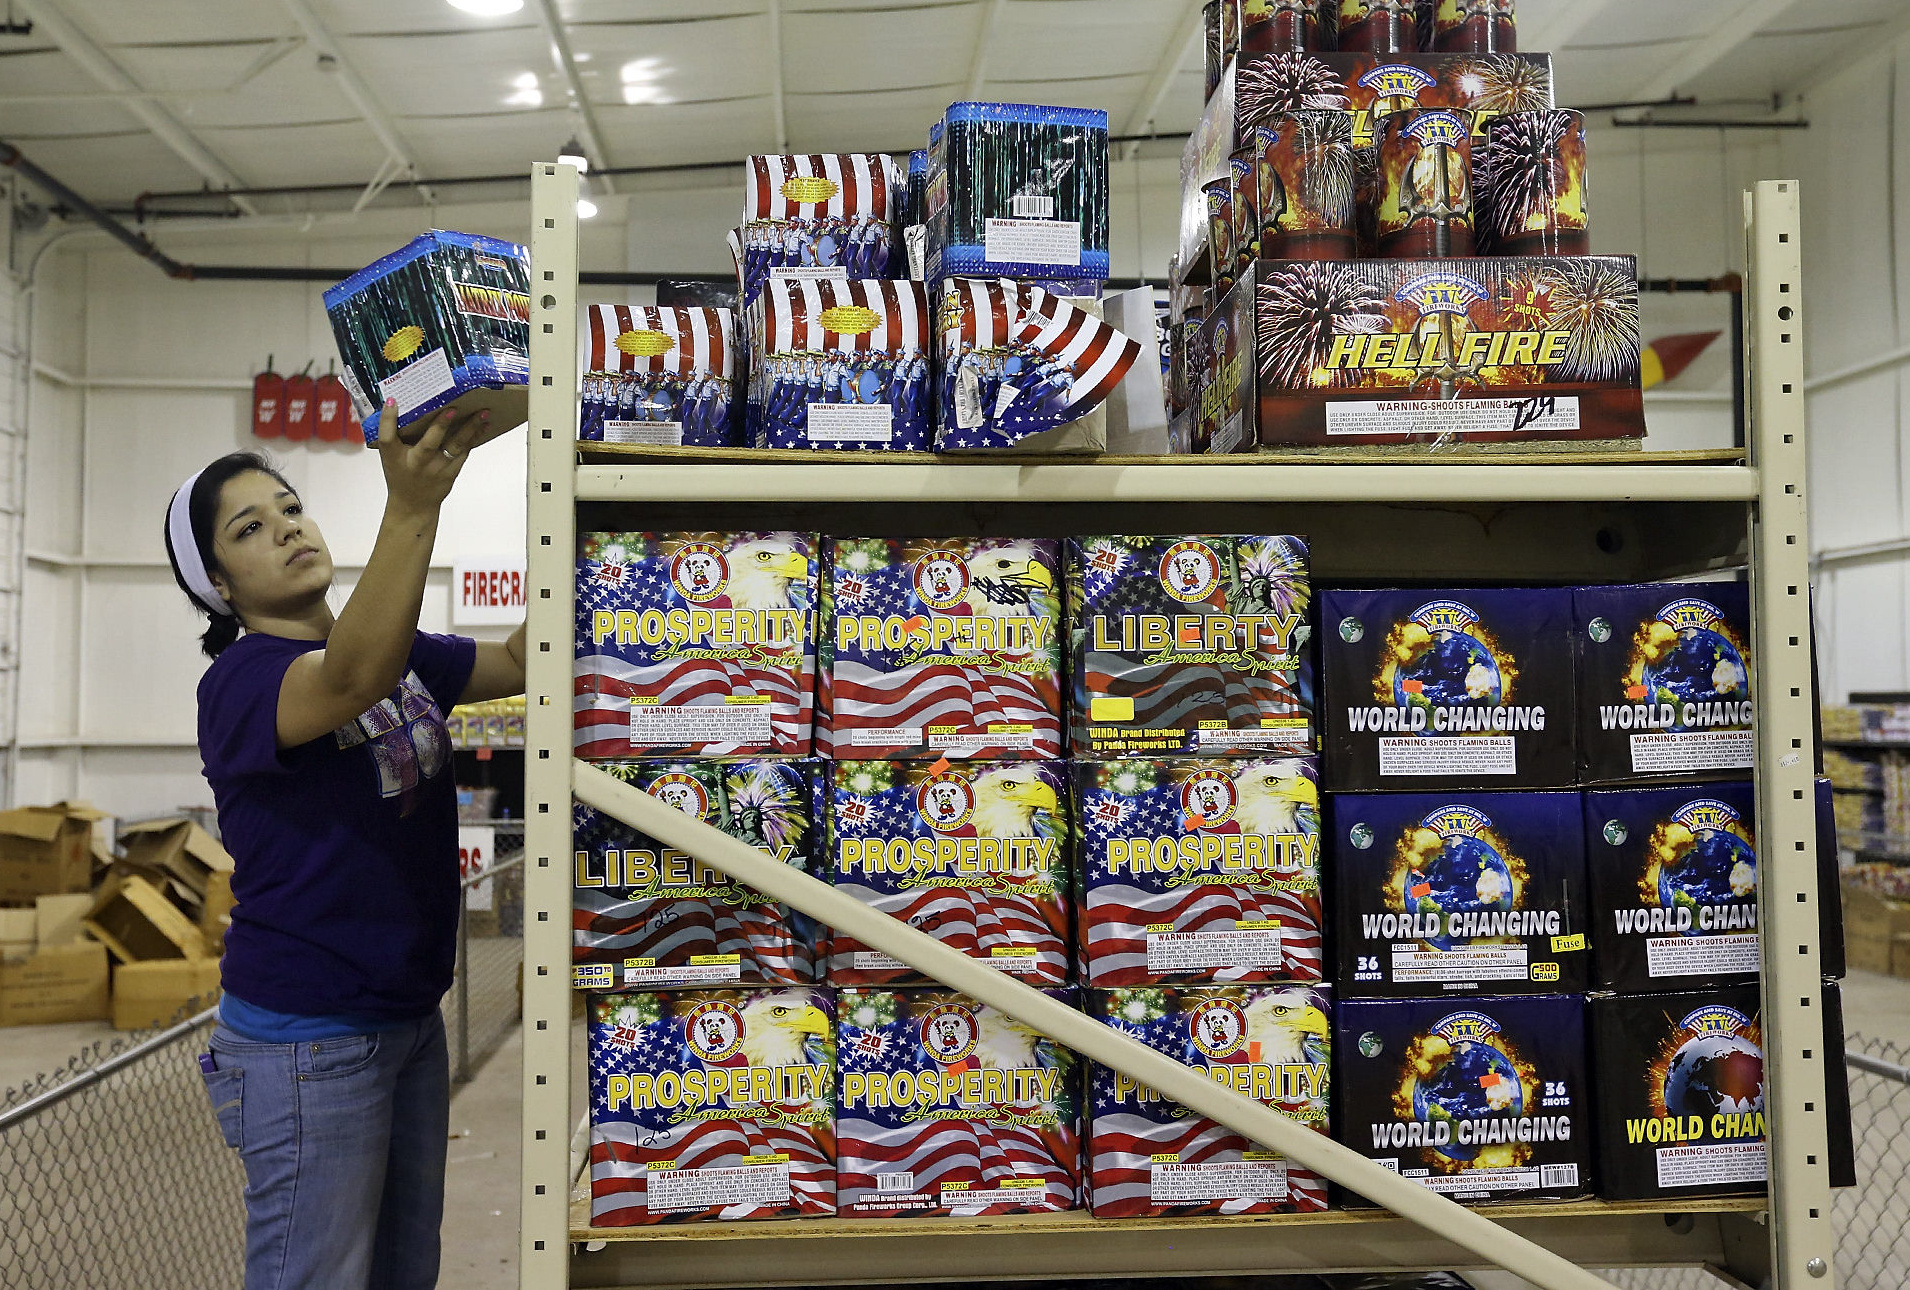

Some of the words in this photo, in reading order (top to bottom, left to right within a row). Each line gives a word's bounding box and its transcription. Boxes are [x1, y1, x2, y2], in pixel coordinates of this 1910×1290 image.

[1526, 292, 1534, 304] 9
[1514, 304, 1541, 316] SHOTS
[1325, 332, 1446, 370] HELL
[1458, 330, 1571, 368] FIRE
[1466, 401, 1501, 410] FLAMING
[1097, 550, 1116, 565] 20
[602, 563, 622, 578] 20
[1091, 560, 1116, 573] SHOTS
[596, 573, 621, 586] SHOTS
[843, 579, 863, 593] 20
[464, 571, 527, 606] FIRECR
[673, 580, 692, 600] WINDA
[693, 579, 727, 601] FIREWORKS
[837, 588, 861, 601] SHOTS
[1162, 579, 1181, 600] WINDA
[1182, 578, 1217, 602] FIREWORKS
[916, 586, 933, 608] WINDA
[934, 586, 967, 608] FIREWORKS
[593, 609, 807, 645] PROSPERITY
[837, 615, 1051, 651] PROSPERITY
[1094, 614, 1300, 651] LIBERTY
[651, 638, 751, 661] America
[744, 644, 803, 671] Spiri
[894, 644, 992, 666] America
[984, 651, 1050, 677] Spirit
[1144, 640, 1241, 666] America
[1233, 646, 1299, 676] Spirit
[1348, 706, 1427, 732] WORLD
[1433, 706, 1546, 731] CHANGING
[1600, 703, 1675, 730] WORLD
[1089, 728, 1119, 738] WINDA
[1120, 729, 1143, 738] Brand
[1144, 728, 1185, 737] Distributed
[1634, 735, 1677, 743] WARNING
[1093, 741, 1102, 750] By
[1104, 740, 1127, 750] Panda
[1128, 740, 1166, 749] Fireworks
[1168, 740, 1183, 749] LTD.
[1383, 738, 1427, 747] WARNING
[845, 801, 866, 816] 20
[1100, 802, 1120, 817] 20
[841, 811, 865, 824] SHOTS
[920, 808, 938, 829] WINDA
[938, 807, 972, 831] FIREWORKS
[1095, 812, 1119, 825] SHOTS
[1205, 805, 1234, 828] IREWORKS
[840, 837, 1056, 873] PROSPERITY
[1107, 832, 1319, 874] PROSPERITY
[628, 874, 732, 901] America
[897, 866, 997, 889] America
[988, 873, 1054, 899] Spirit
[1165, 864, 1261, 887] America
[1253, 869, 1319, 896] Spirit
[1362, 912, 1441, 940] WORLD
[1448, 910, 1560, 937] CHANGING
[1614, 906, 1692, 935] WORLD
[1158, 933, 1196, 941] WARNING
[1556, 938, 1580, 949] Fuse
[1650, 939, 1694, 947] WARNING
[578, 966, 602, 975] 350
[1357, 956, 1378, 970] 36
[1354, 972, 1382, 980] SHOTS
[1532, 965, 1558, 980] GRAMS
[573, 977, 610, 986] GRAMS
[614, 1026, 636, 1042] 20
[861, 1033, 881, 1048] 20
[610, 1036, 635, 1050] SHOTS
[688, 1039, 706, 1060] WINDA
[707, 1038, 742, 1061] FIREWORKS
[857, 1044, 880, 1056] SHOTS
[923, 1040, 940, 1061] WINDA
[941, 1039, 976, 1062] FIREWORKS
[1192, 1036, 1210, 1056] WINDA
[1211, 1035, 1244, 1058] FIREWORKS
[607, 1062, 829, 1111] PROSPERITY
[843, 1067, 1059, 1108] PROSPERITY
[1545, 1082, 1566, 1096] 36
[1542, 1098, 1570, 1106] SHOTS
[667, 1099, 769, 1124] America
[761, 1102, 830, 1130] Spirit
[901, 1099, 1000, 1122] America
[991, 1104, 1059, 1131] Spirit
[1371, 1121, 1451, 1149] WORLD
[1458, 1116, 1571, 1146] CHANGING
[1626, 1115, 1704, 1144] WORLD
[1660, 1148, 1703, 1157] WARNING
[660, 1171, 700, 1180] WARNING
[1424, 1177, 1455, 1185] WARNING
